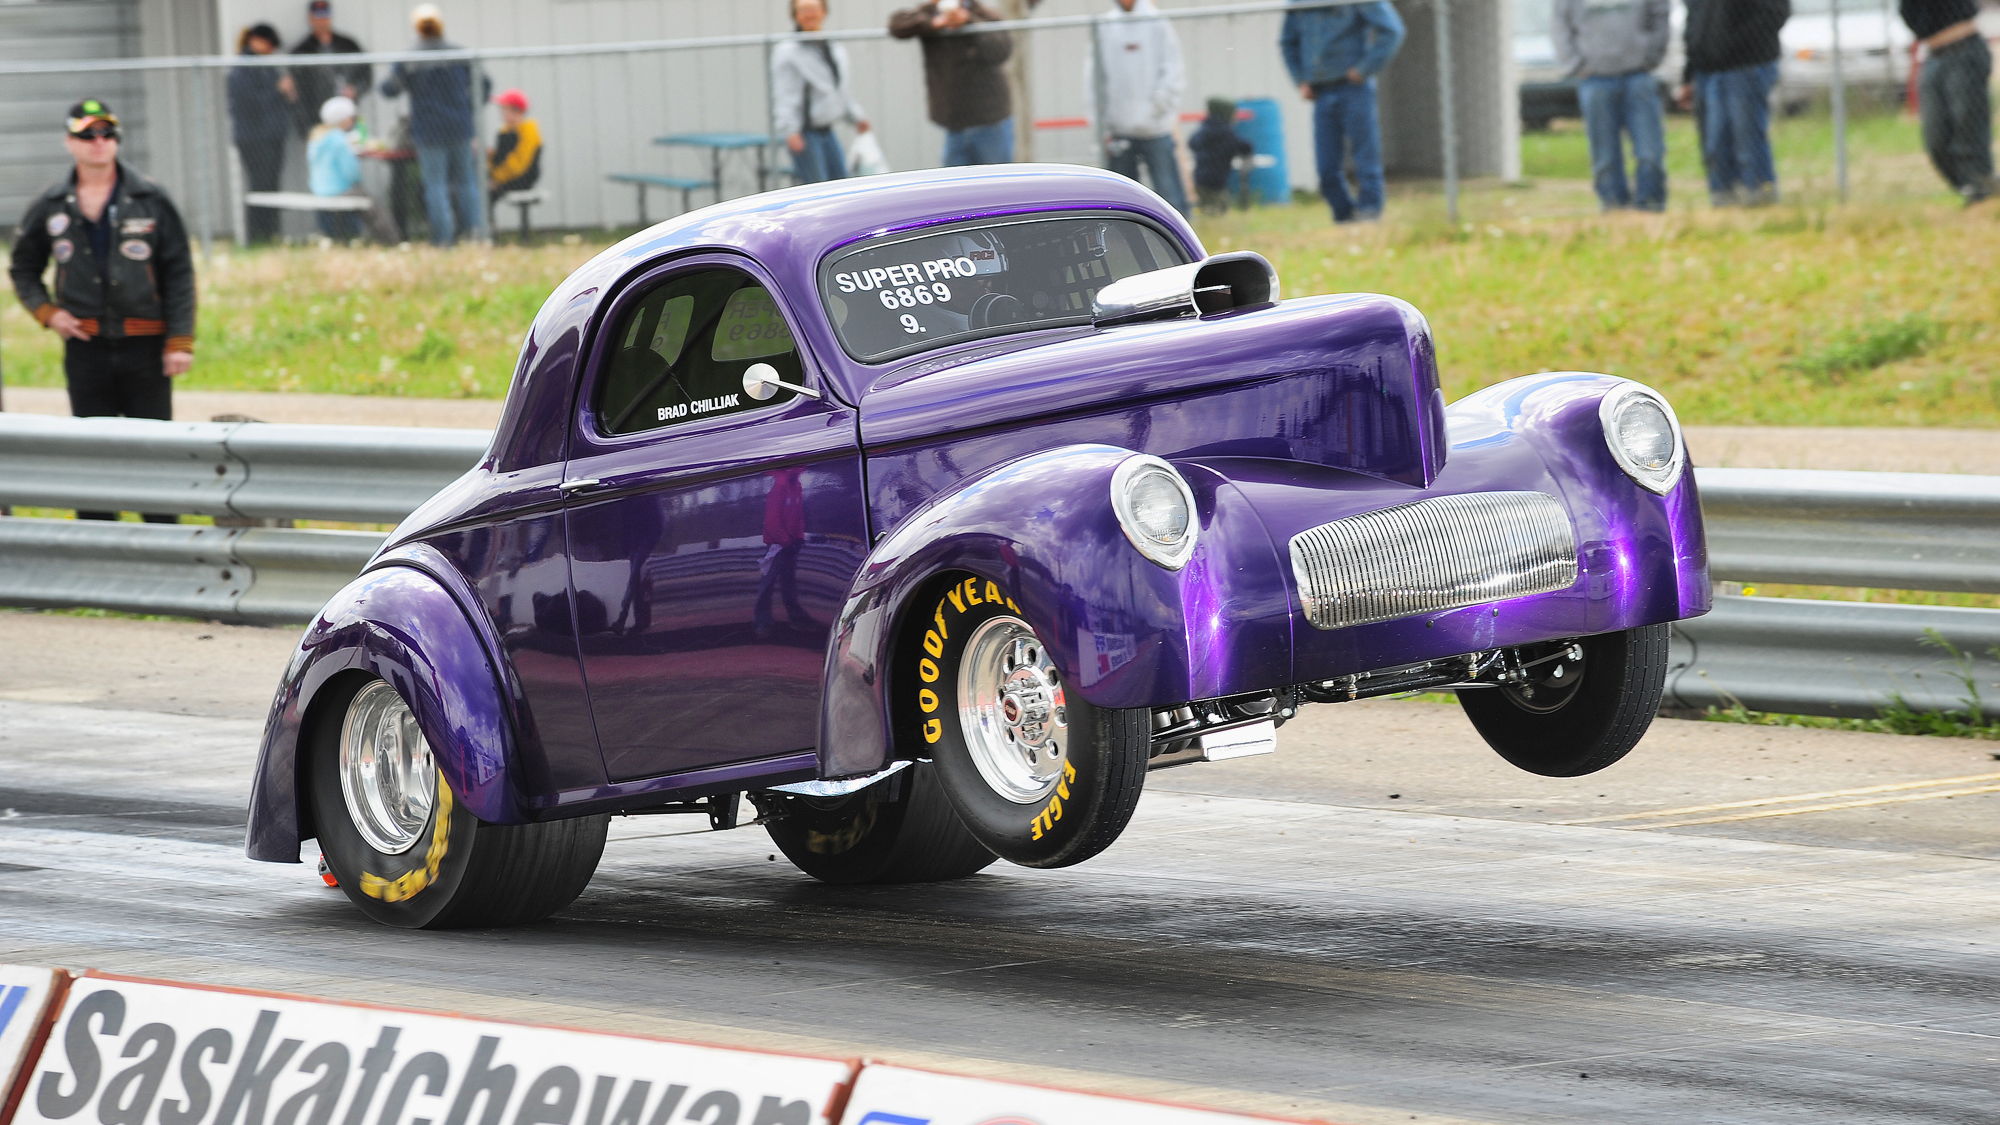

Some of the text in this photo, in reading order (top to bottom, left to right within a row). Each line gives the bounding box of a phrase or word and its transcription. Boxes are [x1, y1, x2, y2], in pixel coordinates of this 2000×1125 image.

[835, 256, 977, 293] SUPER PRO
[879, 282, 951, 310] 6869
[899, 313, 927, 335] 9.
[657, 393, 740, 421] BRAD CHILLIAK
[1031, 758, 1077, 841] EAGLE
